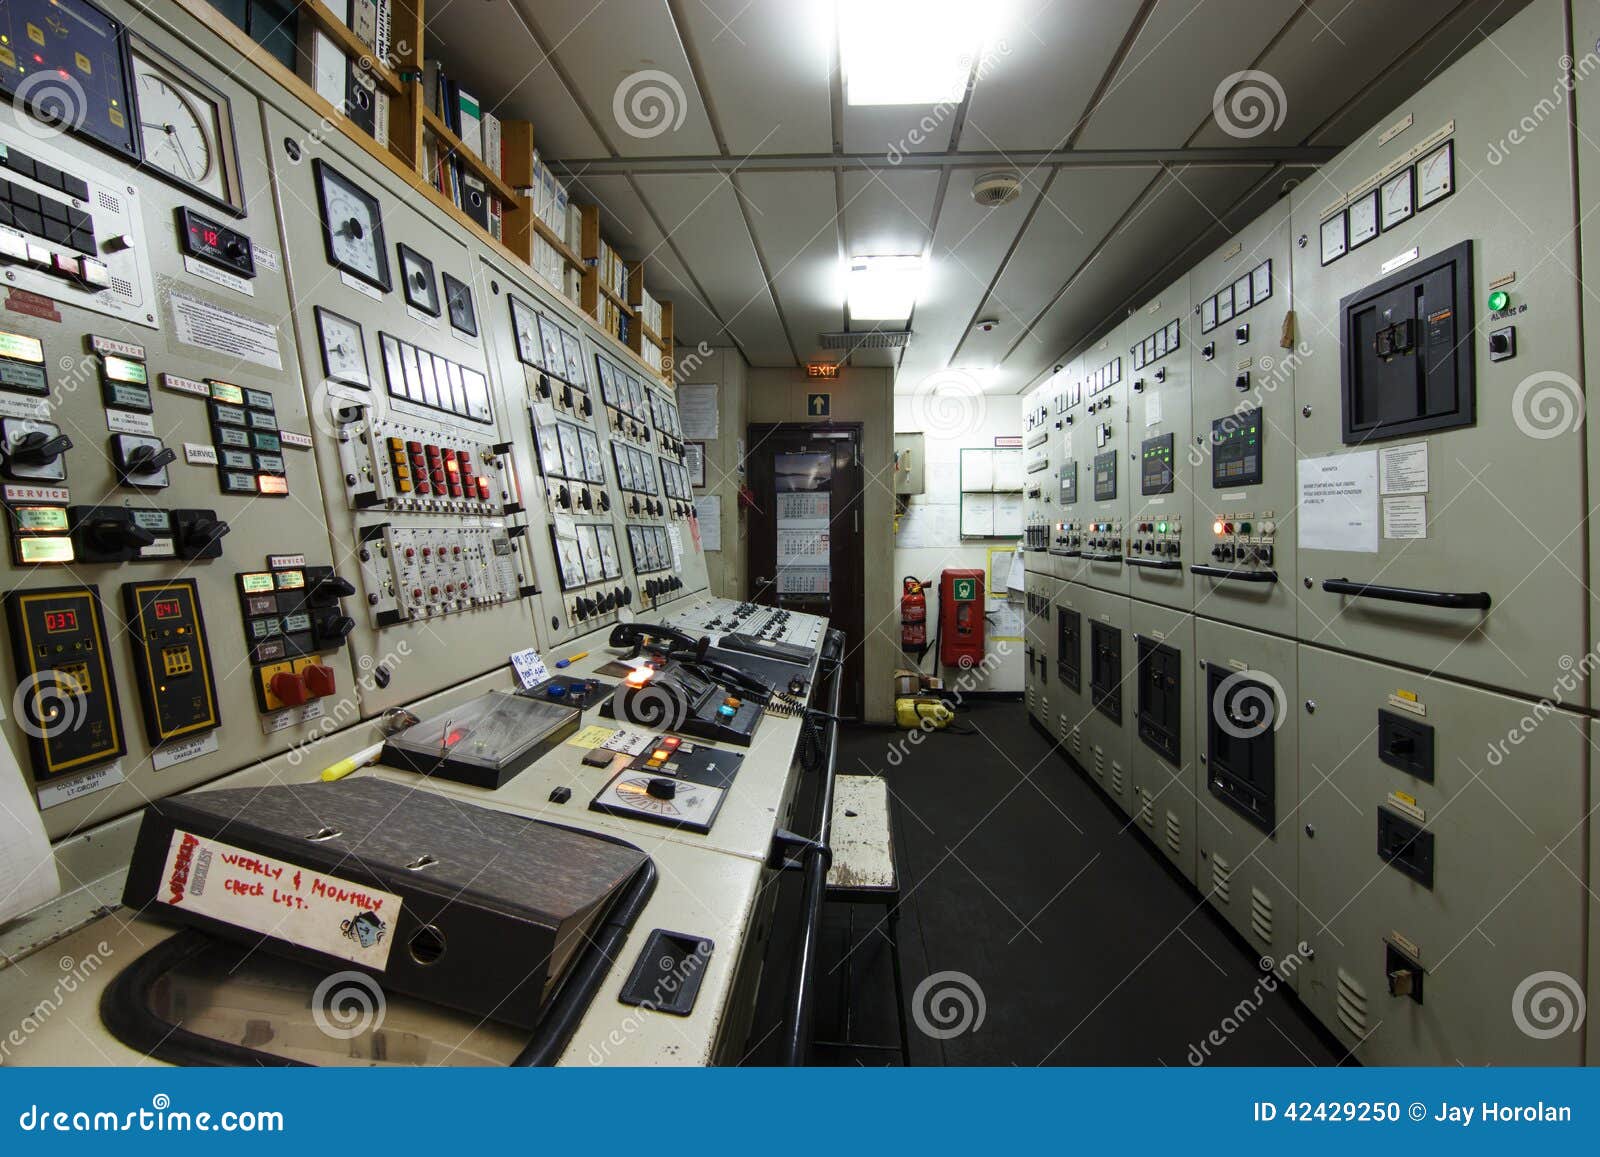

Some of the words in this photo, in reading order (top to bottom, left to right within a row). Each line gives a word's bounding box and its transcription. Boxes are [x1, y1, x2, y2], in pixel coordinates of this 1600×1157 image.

[95, 339, 143, 356] SERVICE
[808, 366, 837, 376] EXIT
[168, 378, 208, 392] SERVICE
[189, 449, 216, 459] SERVICE
[7, 488, 69, 498] SERVICE
[156, 602, 179, 617] 041
[47, 613, 75, 630] 037
[56, 776, 84, 791] COOLING
[86, 769, 108, 782] WATER
[221, 853, 283, 881] WEEKLY
[311, 878, 384, 912] MONTHLY
